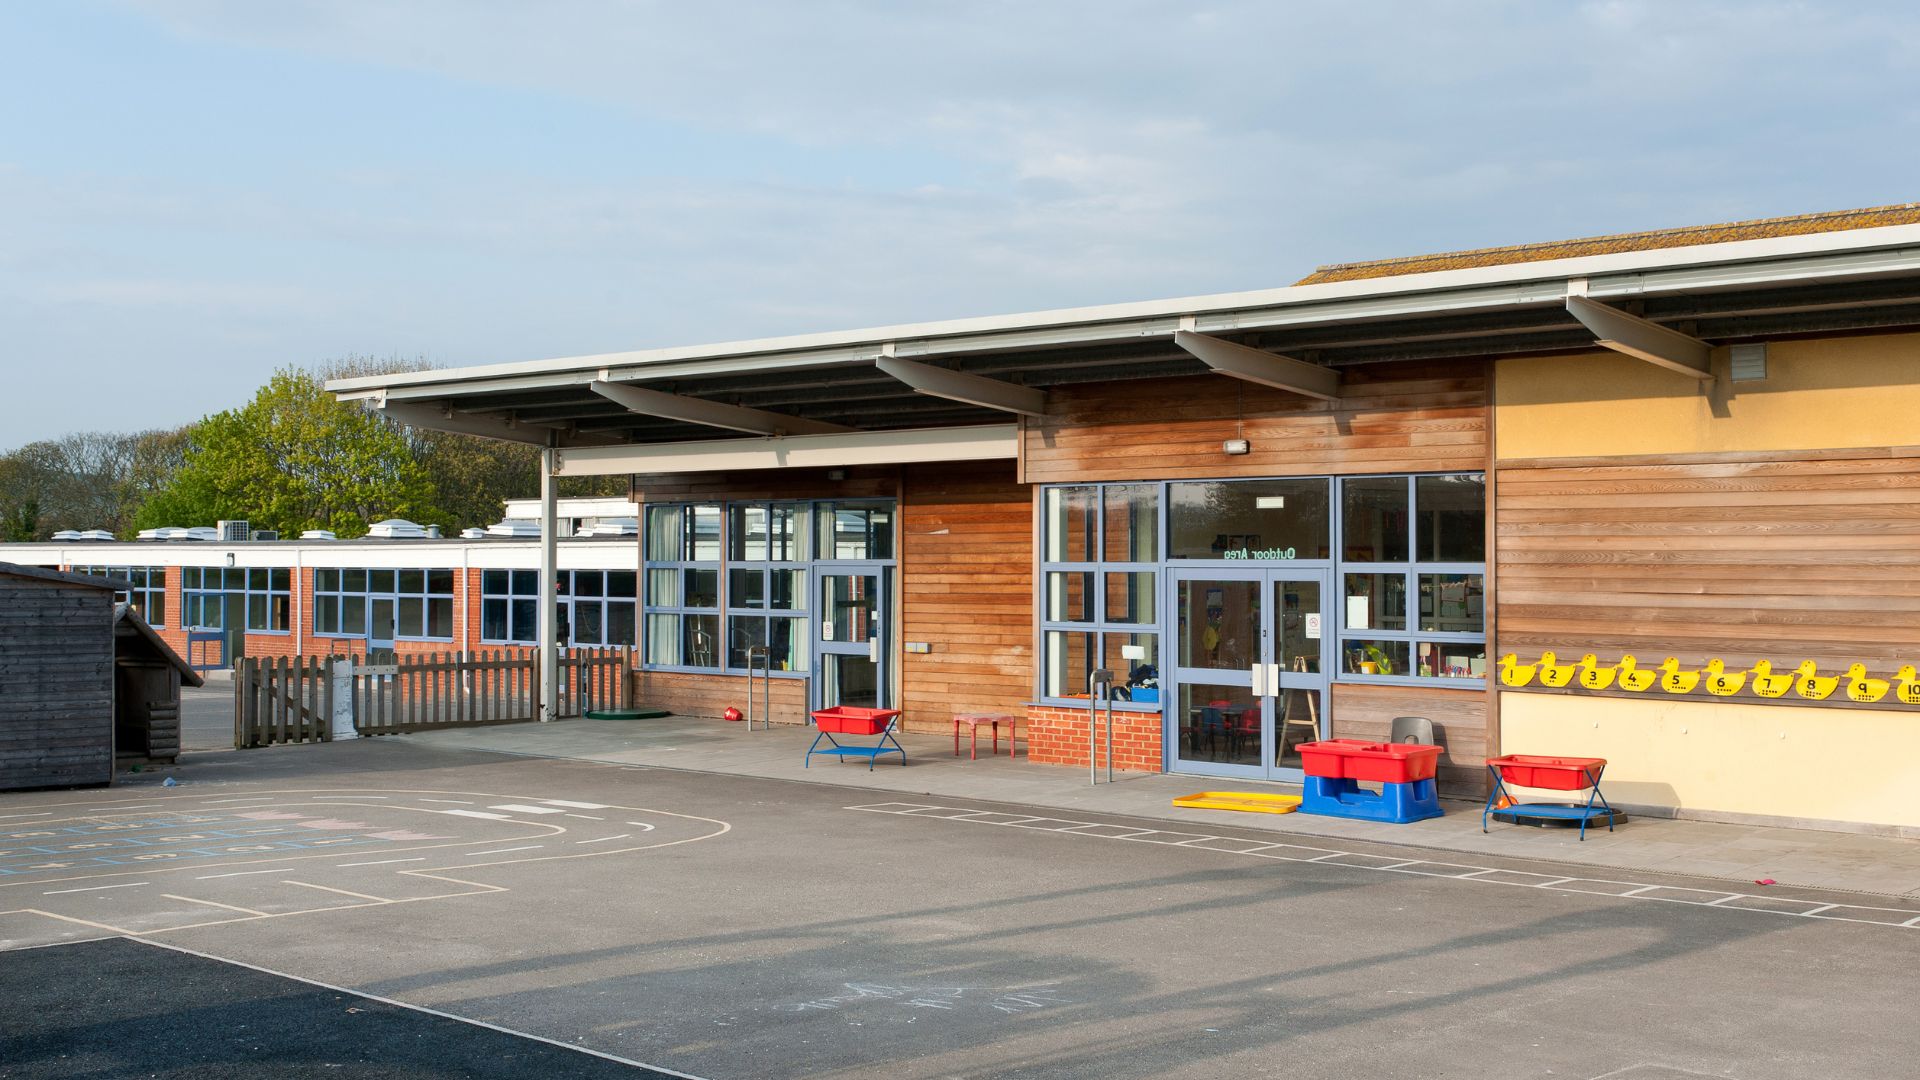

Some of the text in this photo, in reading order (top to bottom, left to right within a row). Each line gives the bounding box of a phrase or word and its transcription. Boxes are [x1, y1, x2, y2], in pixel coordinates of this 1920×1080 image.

[1509, 669, 1514, 679] 1
[1548, 669, 1557, 680] 2
[1589, 671, 1598, 682] 3
[1628, 672, 1637, 683] 4
[1671, 674, 1680, 685] 5
[1716, 677, 1726, 688] 6
[1763, 678, 1771, 689] 7
[1806, 679, 1816, 690] 8
[1858, 682, 1868, 694] 9
[1908, 684, 1920, 695] 10
